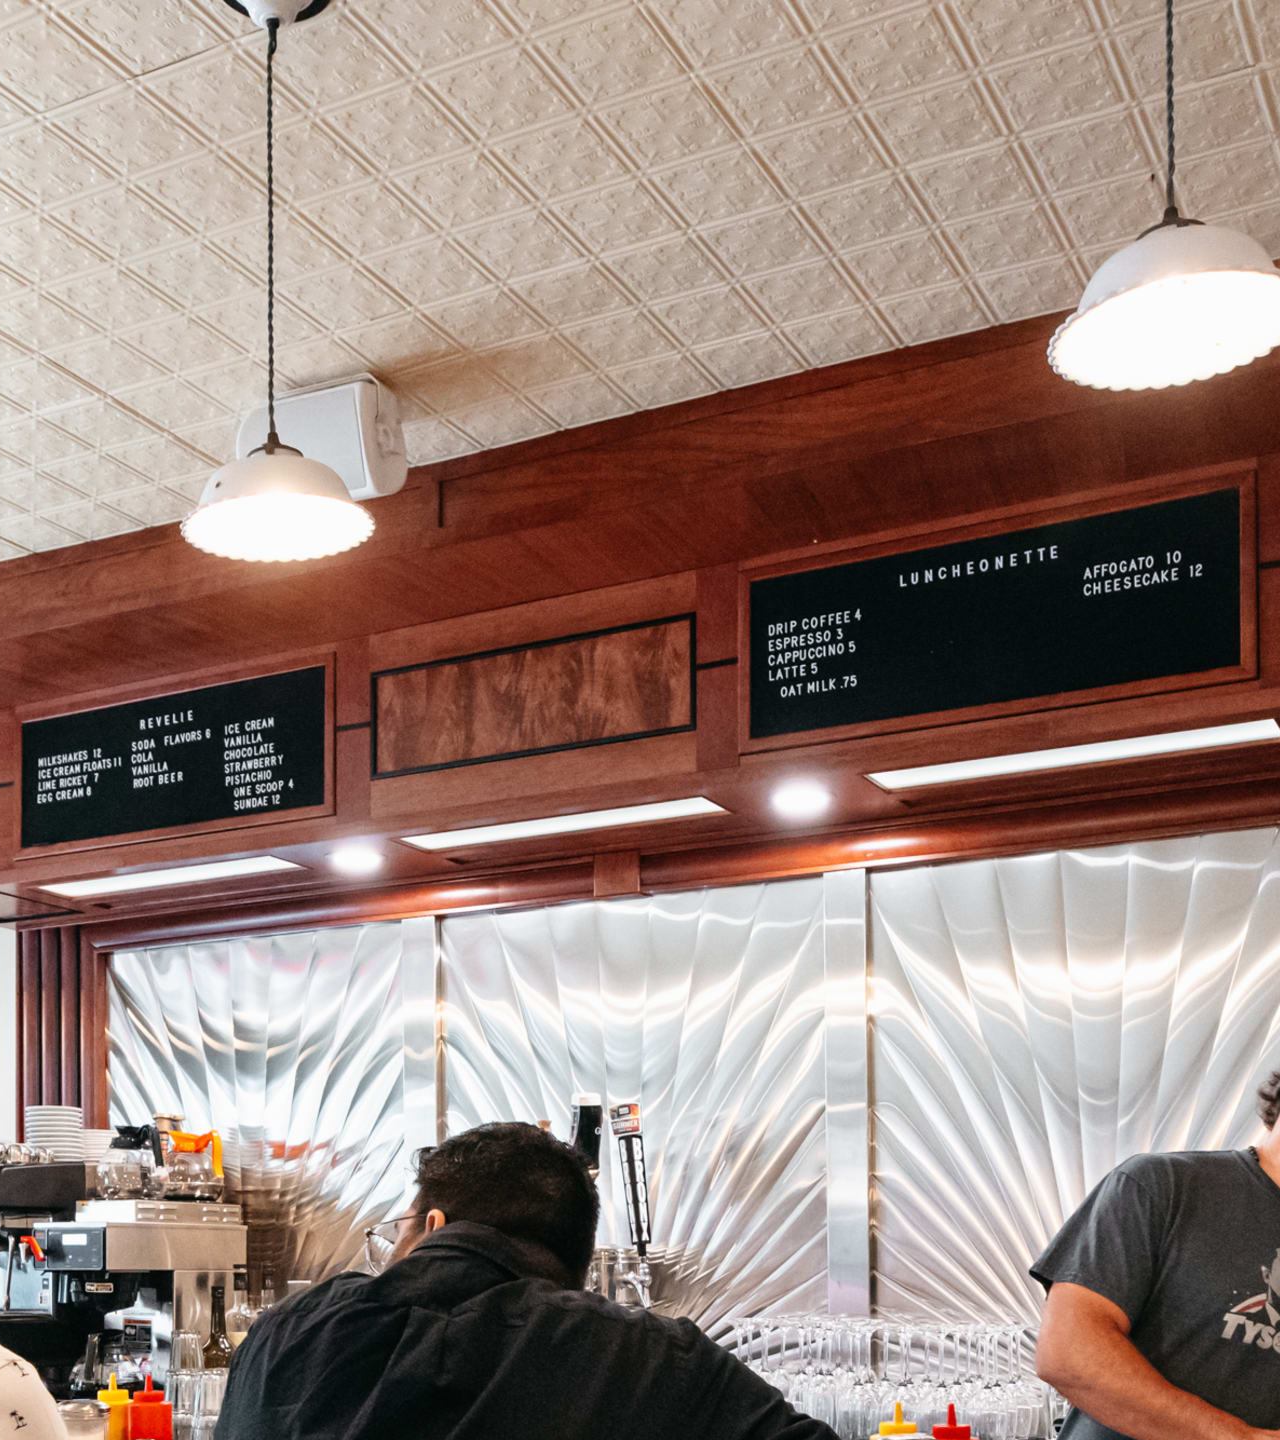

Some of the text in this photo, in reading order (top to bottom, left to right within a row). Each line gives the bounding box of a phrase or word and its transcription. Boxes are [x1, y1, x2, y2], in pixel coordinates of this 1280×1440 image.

[899, 545, 1059, 587] LUNCHEONETTE
[1083, 550, 1181, 580] AFFOGATO 10
[1083, 563, 1203, 596] CHEESECAKE 12
[768, 608, 862, 636] DRIP COFFEE 4
[768, 628, 843, 652] ESPRESSO 3
[768, 641, 856, 666] CAPPUCCINO 5
[768, 662, 818, 681] LATTE 5
[780, 675, 857, 698] OAT MILK .75
[139, 710, 193, 730] REVELIE
[224, 717, 275, 735] ICE CREAM
[131, 728, 211, 752] SODA FLAVORS 6
[224, 732, 263, 748] VANILLA
[38, 748, 101, 767] MILKSHAKES 12
[131, 751, 153, 764] COLA
[224, 743, 275, 761] CHOCOLATE
[38, 757, 122, 780] ICE CREAM FLOATS 11
[132, 761, 168, 776] VANILLA
[224, 754, 284, 774] STRAWBERRY
[38, 773, 99, 792] LIME RICKEY 7
[133, 771, 183, 789] ROOT BEER
[225, 770, 272, 787] PISTACHIO
[233, 778, 294, 797] ONE SCOOP 4
[37, 786, 92, 804] EGG CREAM 8
[234, 794, 280, 810] SUNDAE 12
